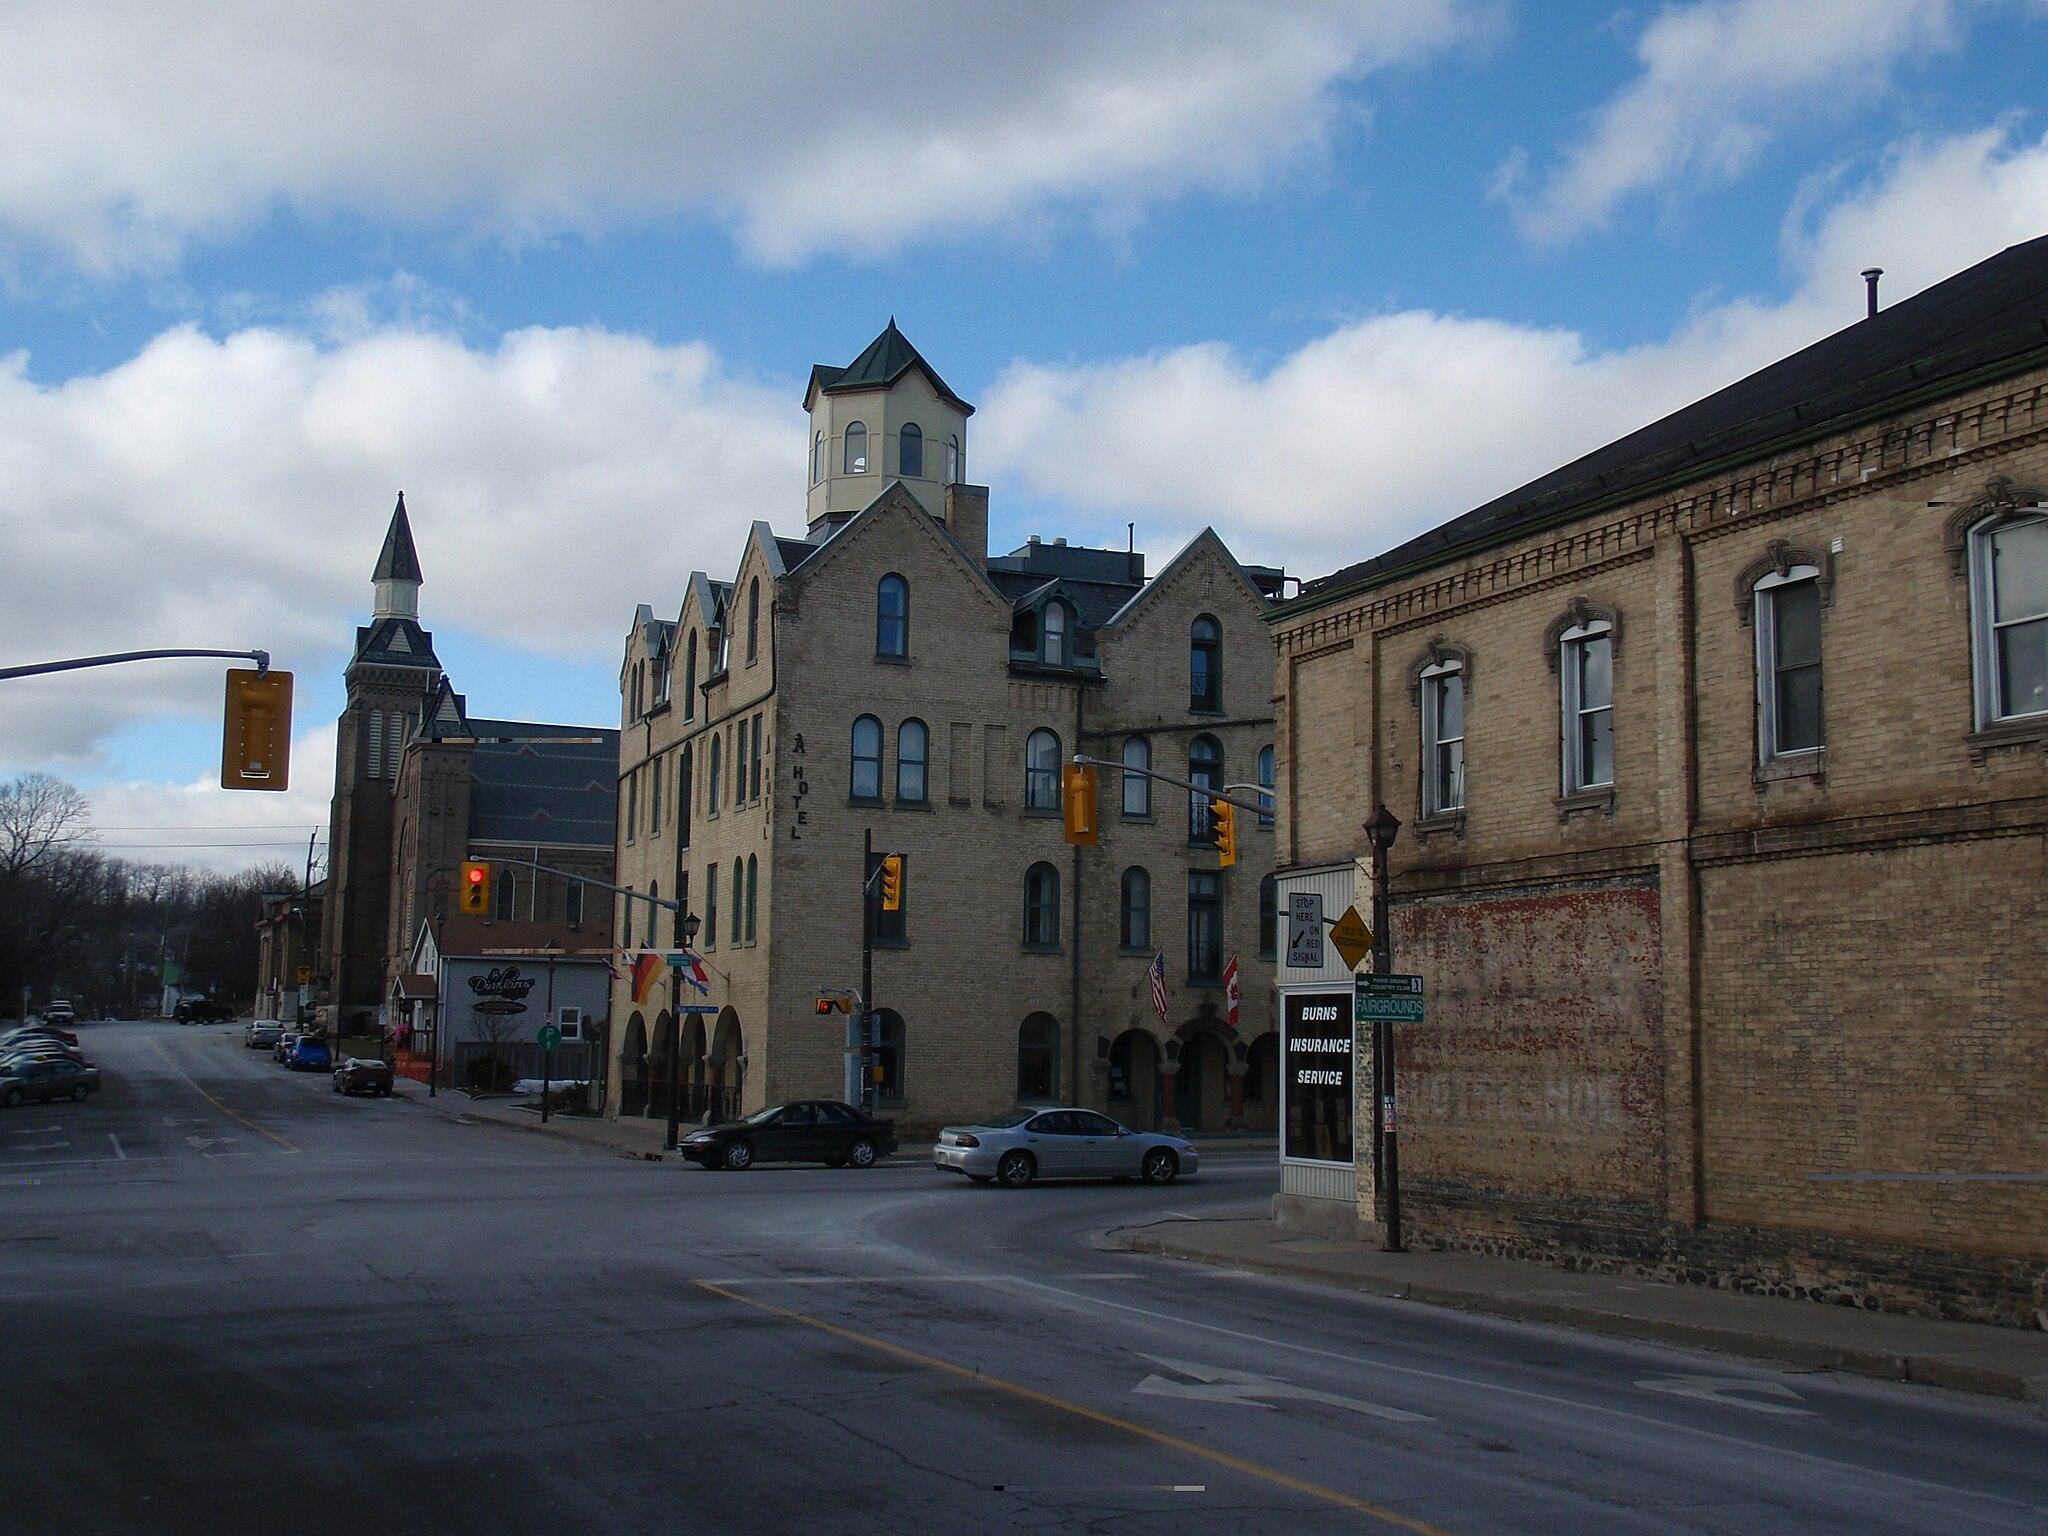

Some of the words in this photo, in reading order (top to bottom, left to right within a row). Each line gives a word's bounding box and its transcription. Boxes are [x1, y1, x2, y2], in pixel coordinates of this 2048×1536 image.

[792, 733, 805, 754] A
[791, 765, 808, 840] HOTEL
[1296, 898, 1314, 909] STOP
[1296, 912, 1314, 922] HERE
[1309, 926, 1320, 935] ON
[1306, 939, 1320, 949] RED
[1292, 952, 1318, 962] SIGNAL
[1356, 999, 1423, 1014] FAIRGROUNDS
[1302, 1006, 1338, 1021] BURNS
[546, 1028, 554, 1040] P
[1290, 1038, 1351, 1053] INSURANCE
[1297, 1069, 1343, 1085] SERVICE
